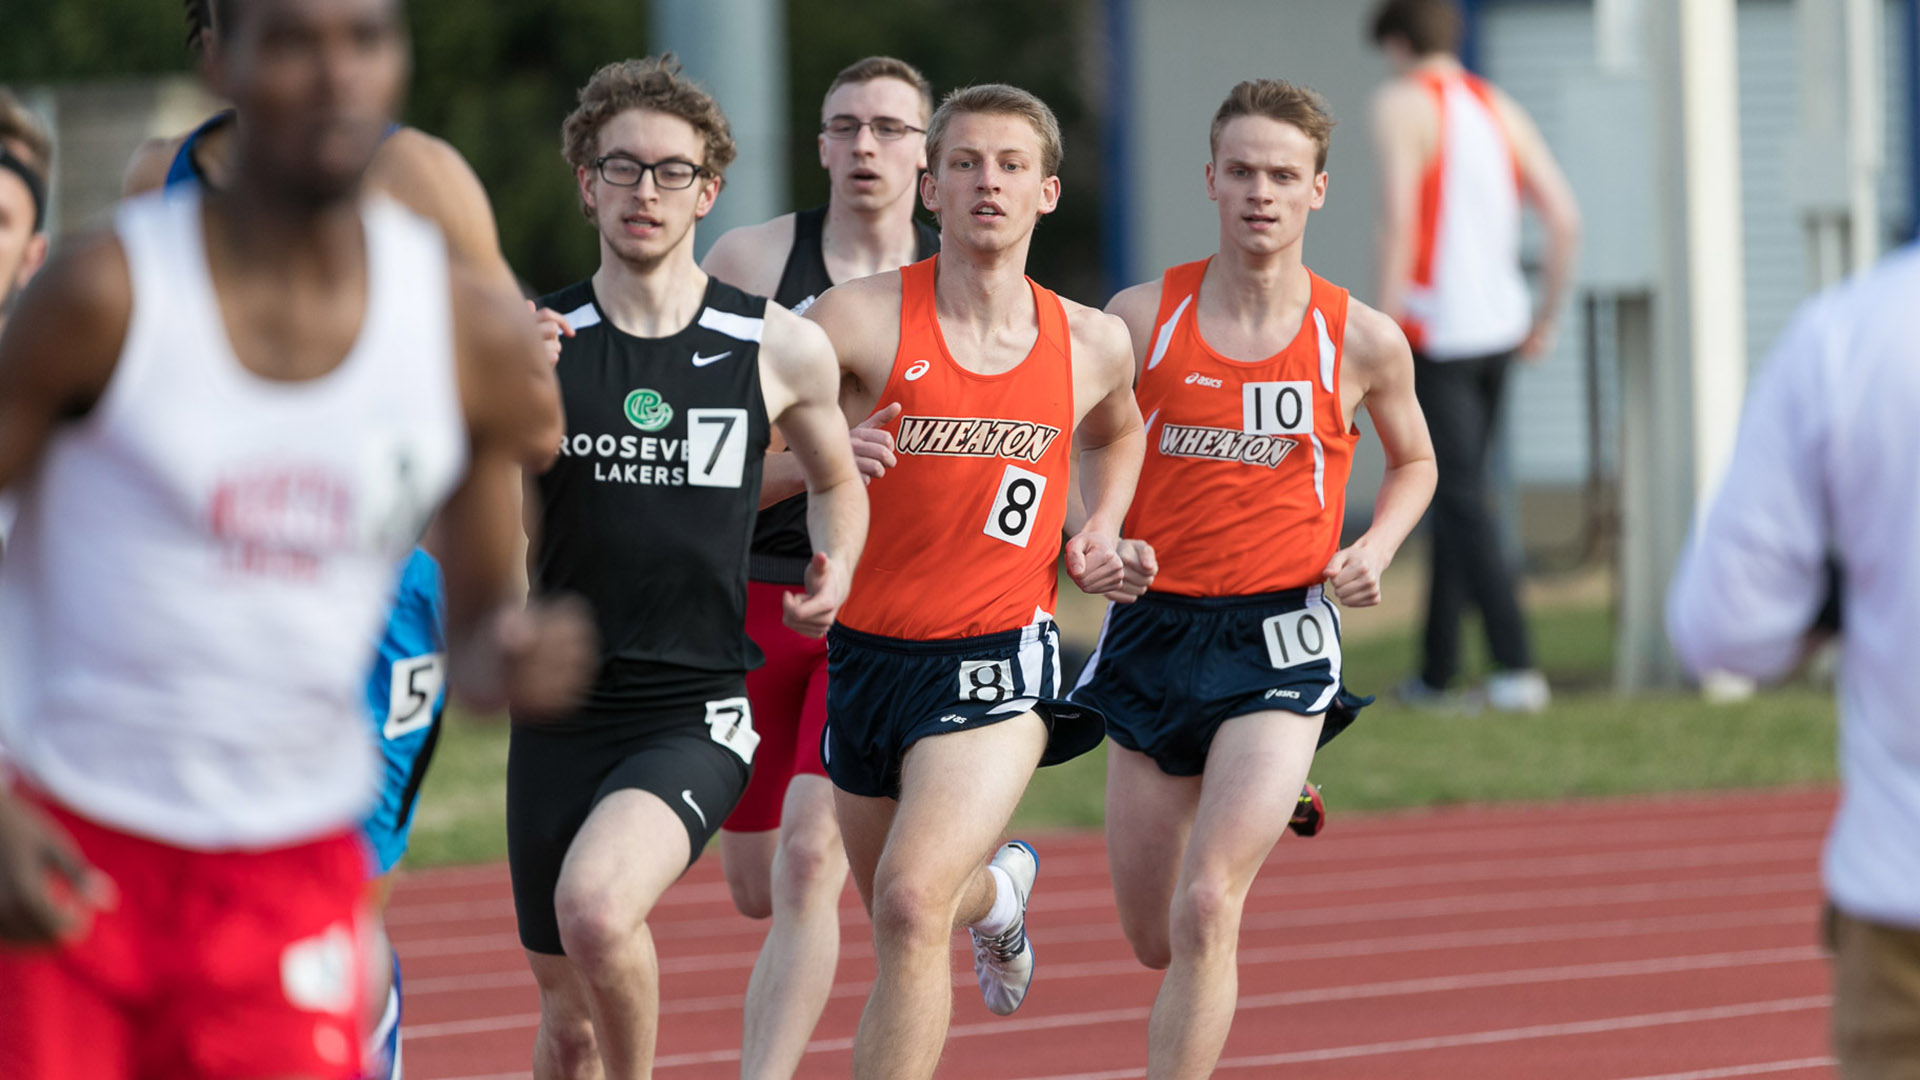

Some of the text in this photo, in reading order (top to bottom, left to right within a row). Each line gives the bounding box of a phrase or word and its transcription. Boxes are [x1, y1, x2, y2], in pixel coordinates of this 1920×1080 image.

[1255, 387, 1303, 430] 10
[698, 416, 737, 475] 7
[896, 416, 1061, 463] WHEATON
[1159, 423, 1298, 469] WHEATON
[594, 462, 685, 486] LAKERS
[998, 478, 1036, 536] 8
[1273, 614, 1324, 663] 10
[396, 663, 433, 722] 5
[969, 664, 1005, 701] 8
[716, 705, 743, 742] 7
